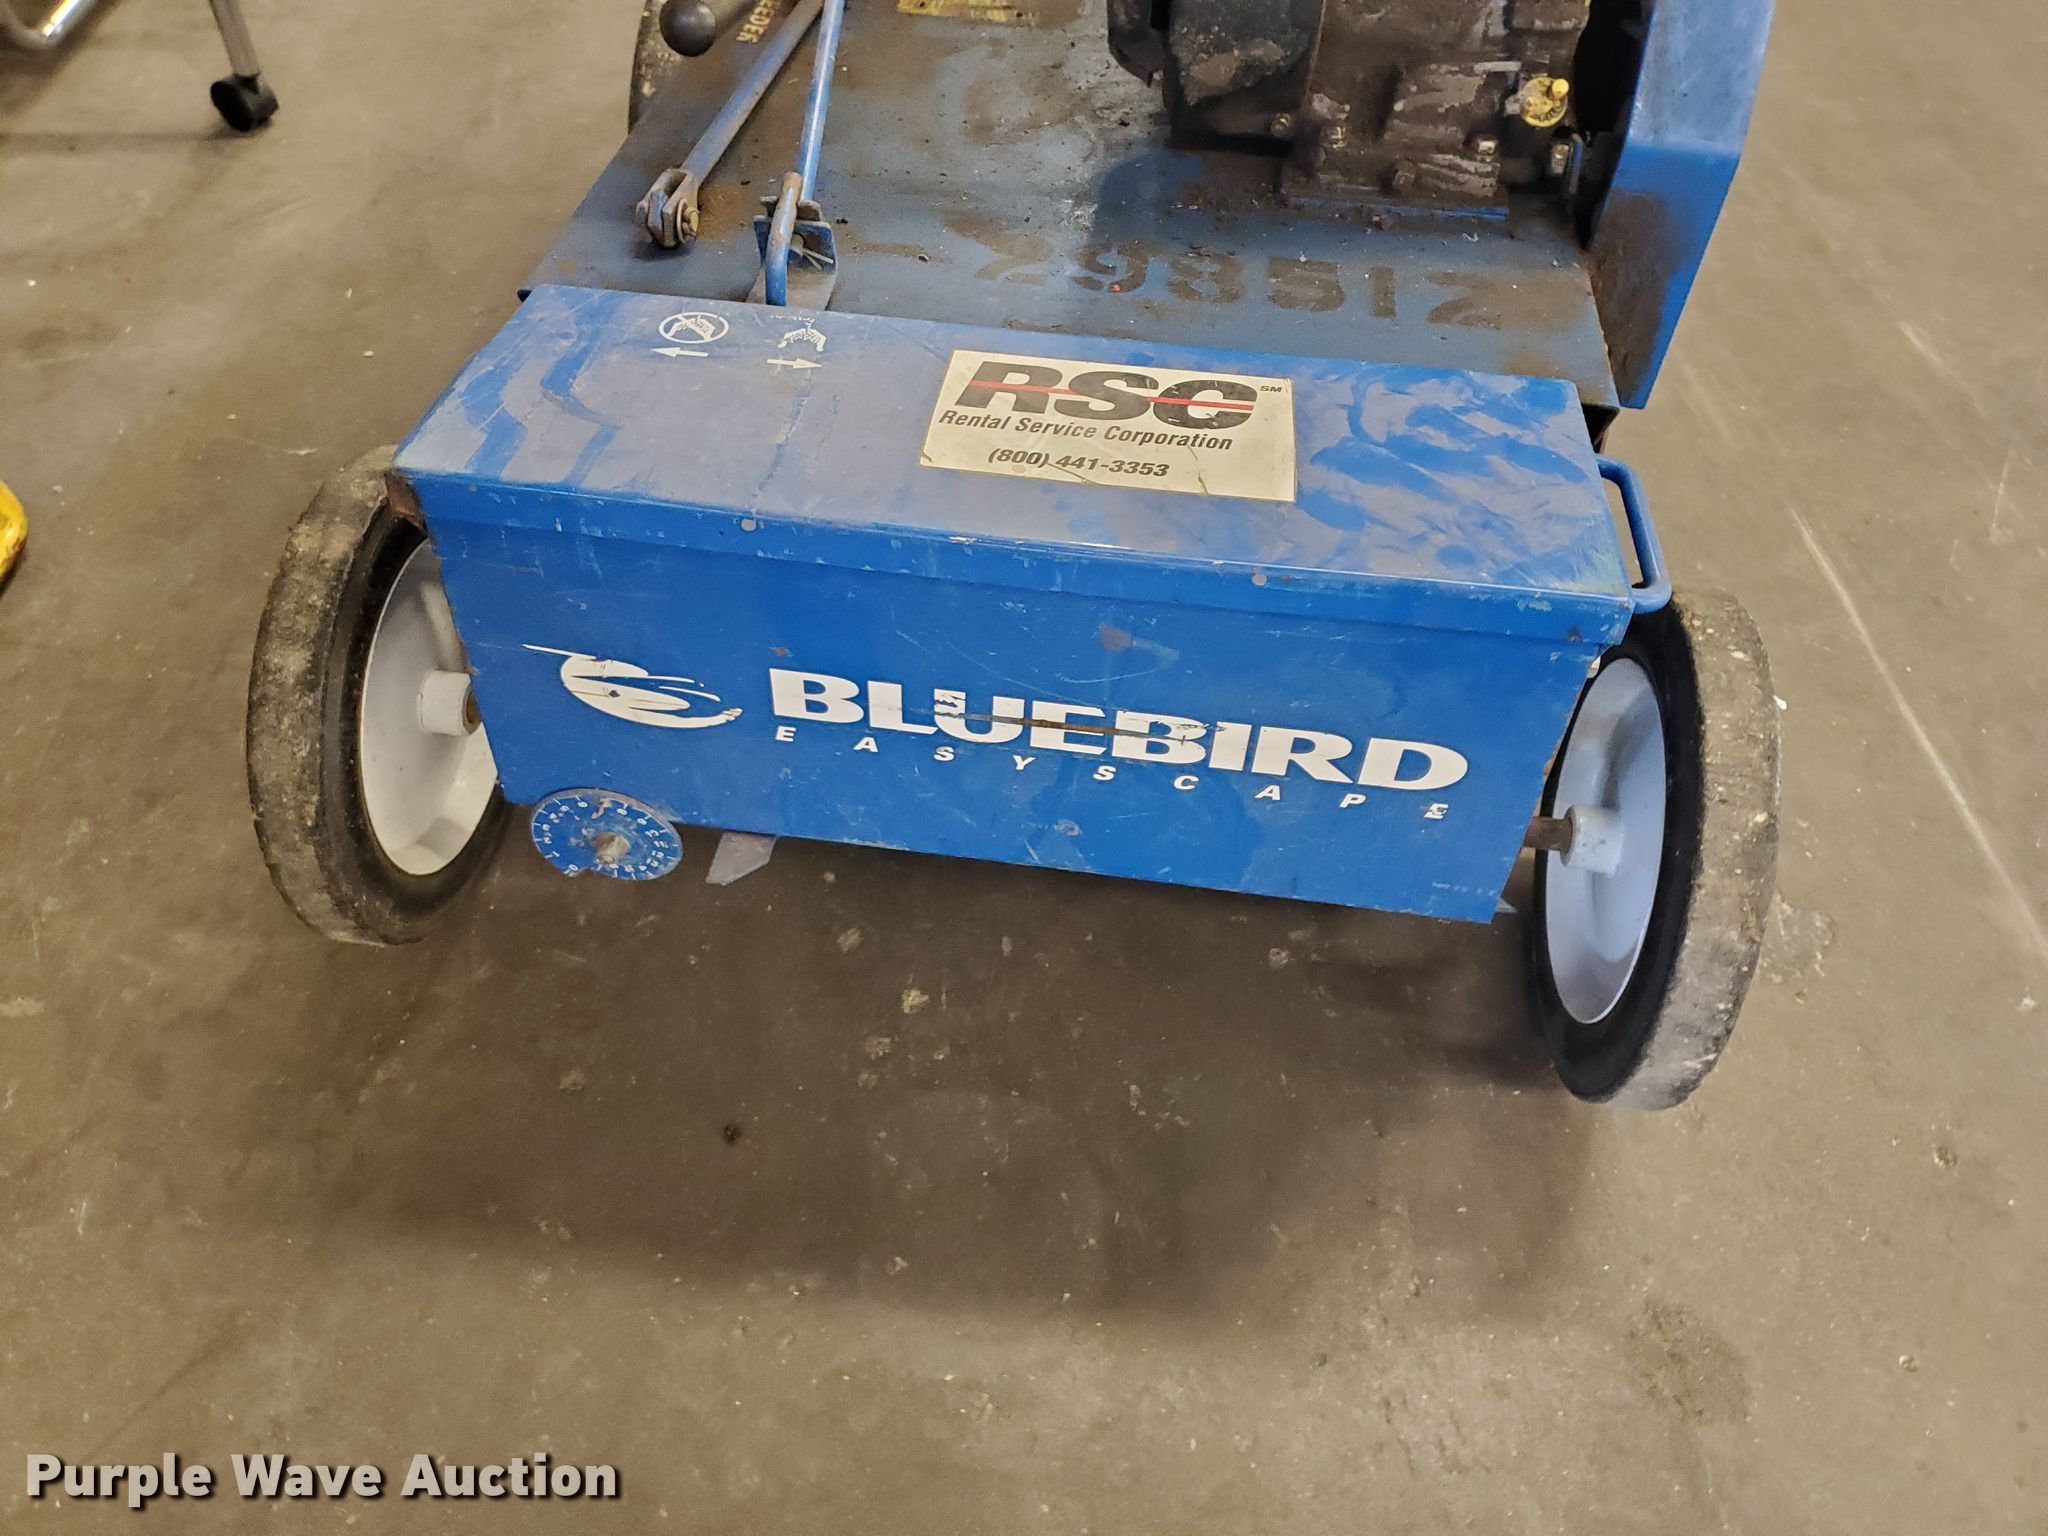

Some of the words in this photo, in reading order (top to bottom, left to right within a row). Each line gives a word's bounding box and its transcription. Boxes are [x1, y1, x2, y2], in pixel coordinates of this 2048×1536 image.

[953, 361, 1258, 430] RSC
[1259, 385, 1283, 393] SM
[938, 410, 1009, 431] Rental
[1014, 417, 1097, 439] Service
[1104, 425, 1234, 450] Corporation
[988, 448, 1050, 468] (800)
[1056, 455, 1171, 478] 441-3353
[769, 667, 1469, 791] BLUEBIRD
